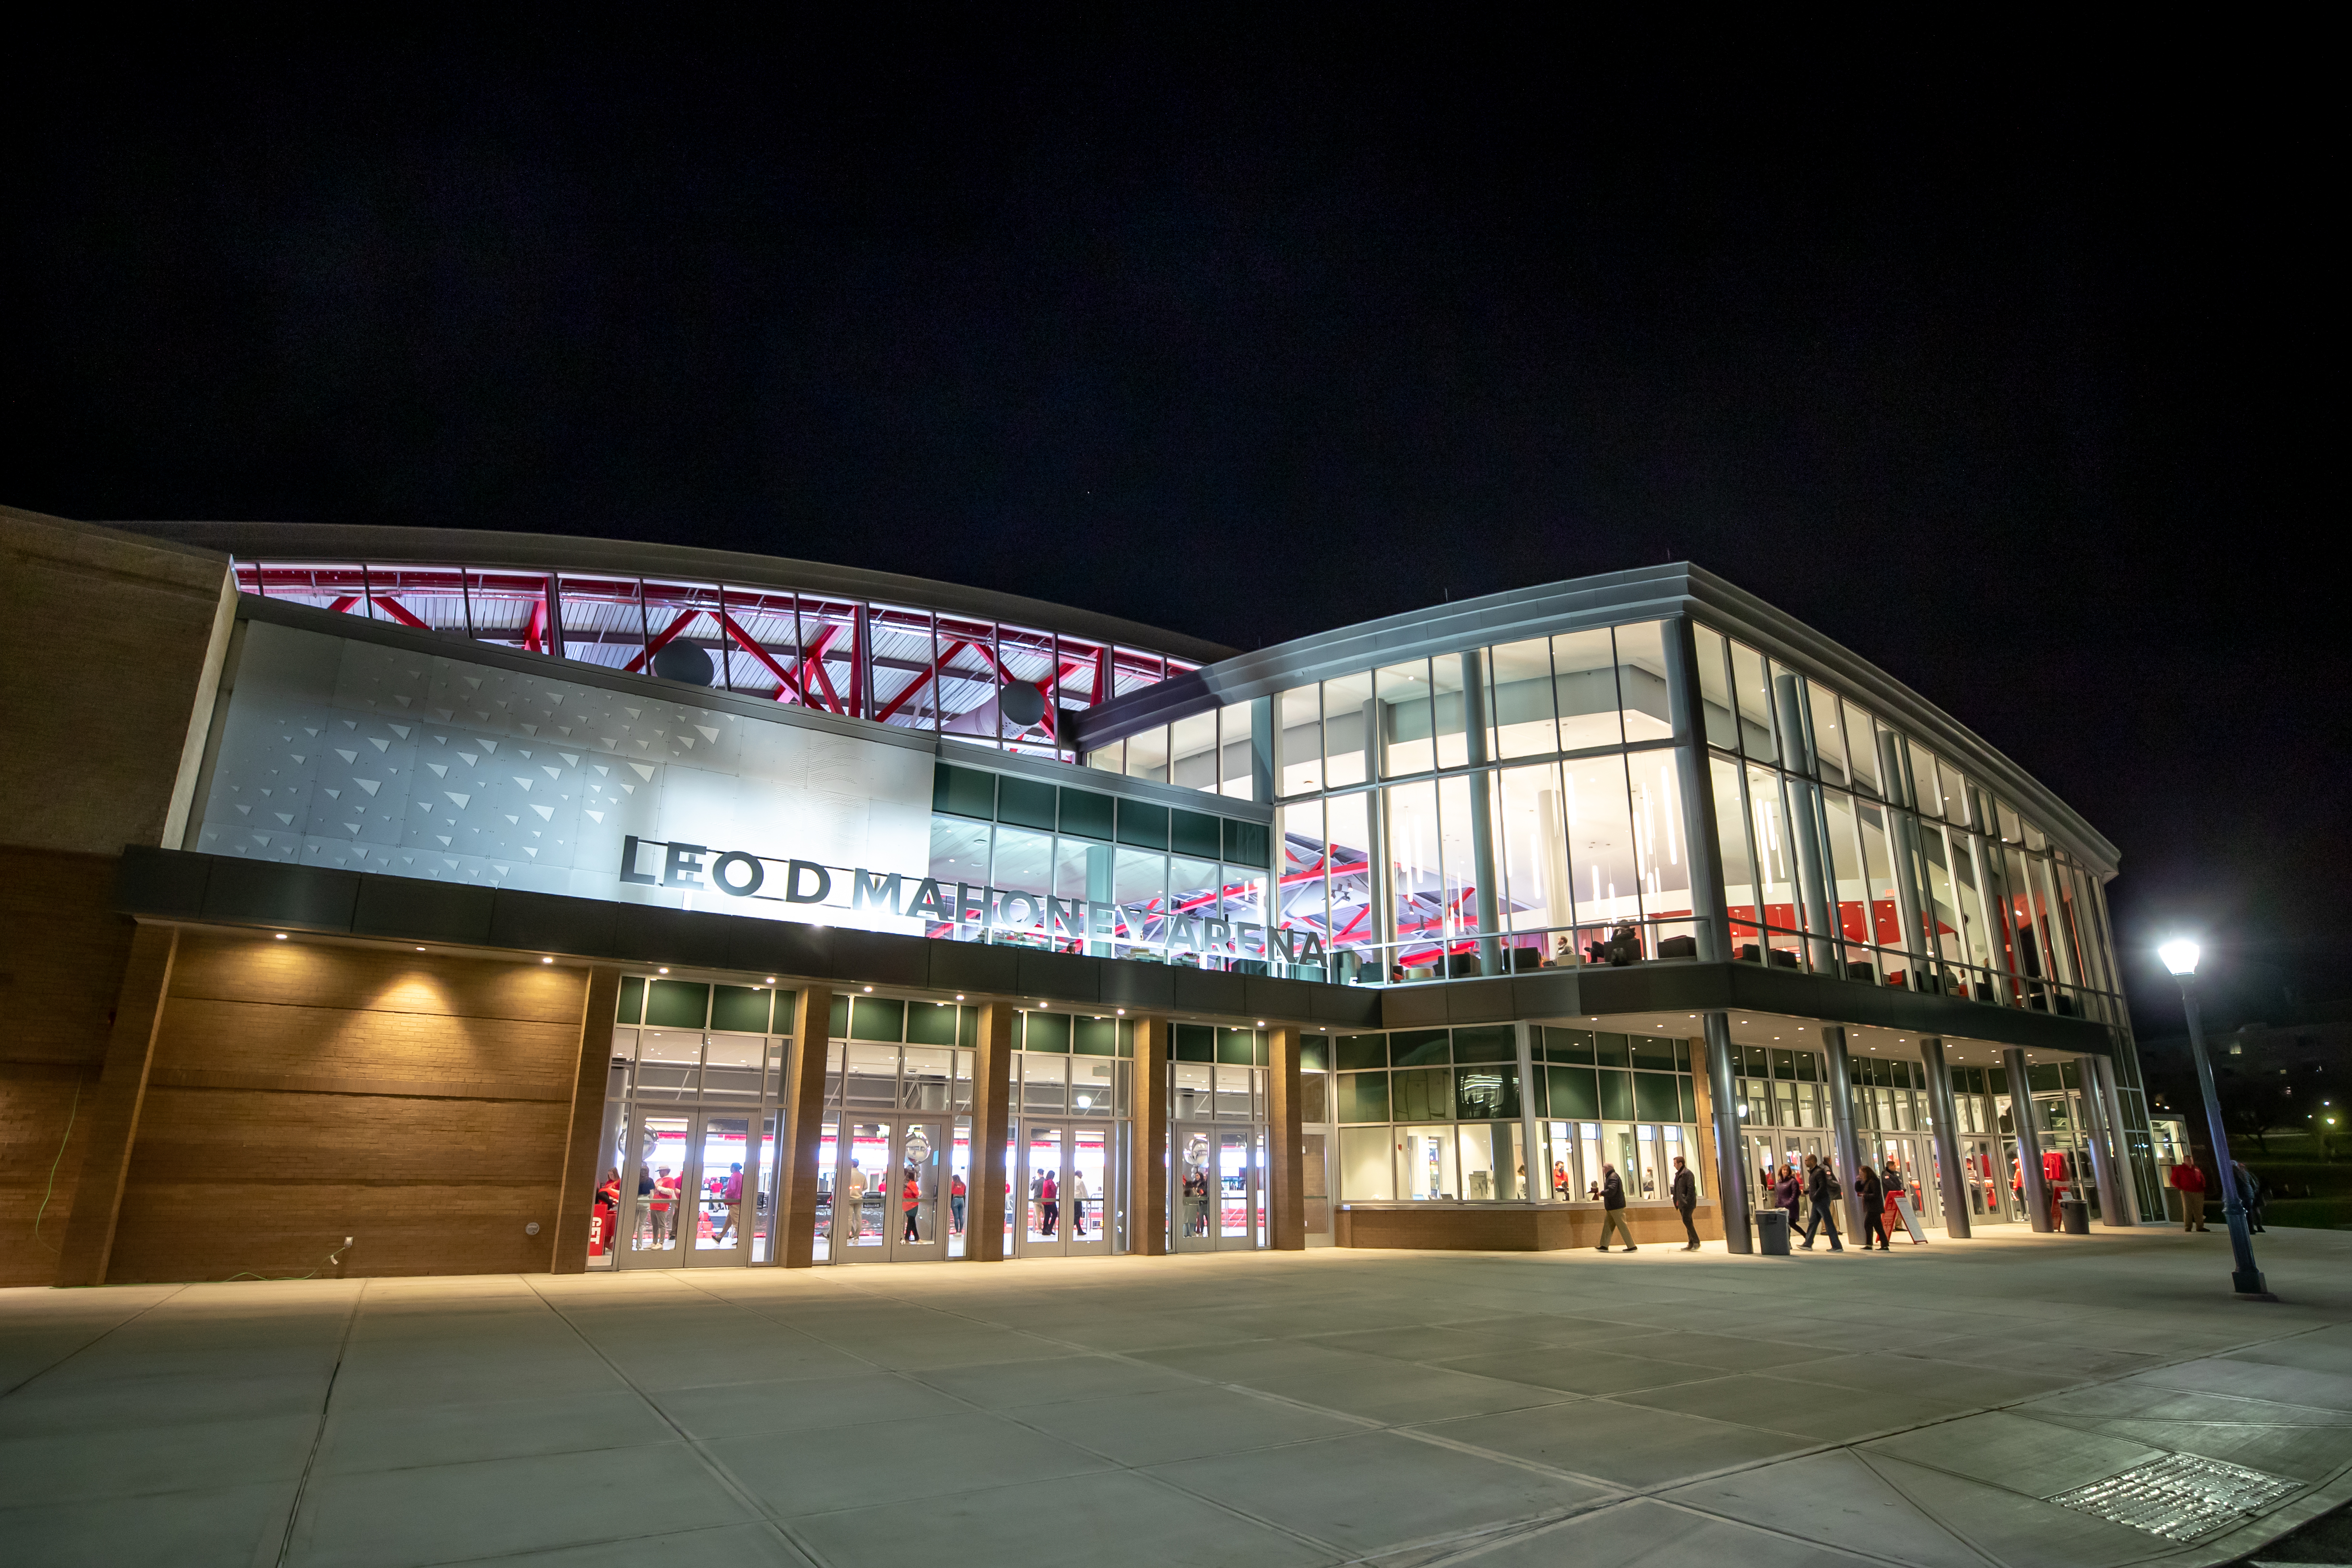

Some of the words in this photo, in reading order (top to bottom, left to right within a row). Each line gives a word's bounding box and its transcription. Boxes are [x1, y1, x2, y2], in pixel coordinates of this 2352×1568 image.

[620, 835, 764, 897] LEO
[786, 859, 831, 904] D
[852, 868, 1152, 941] MAHONEY
[1165, 913, 1328, 968] ARENA
[590, 1217, 602, 1245] GET
